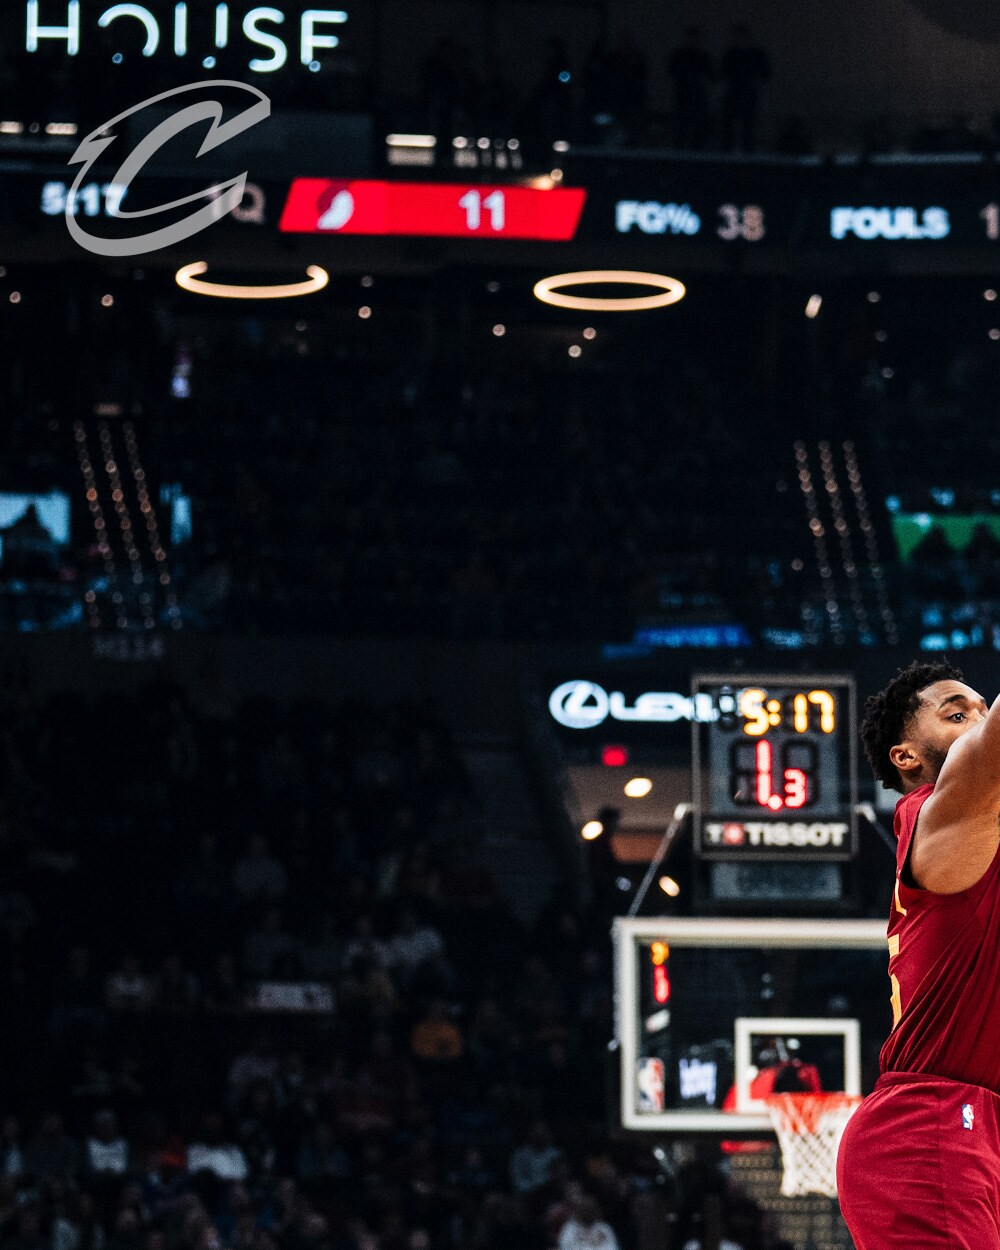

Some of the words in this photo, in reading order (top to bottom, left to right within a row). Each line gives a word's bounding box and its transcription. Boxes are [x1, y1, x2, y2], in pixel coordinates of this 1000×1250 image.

[458, 189, 505, 231] 11
[616, 200, 700, 236] FG%
[717, 204, 765, 241] 38
[831, 206, 949, 240] FOULS
[980, 207, 999, 240] 1
[739, 688, 835, 736] 5:17
[745, 822, 849, 847] TISSOT
